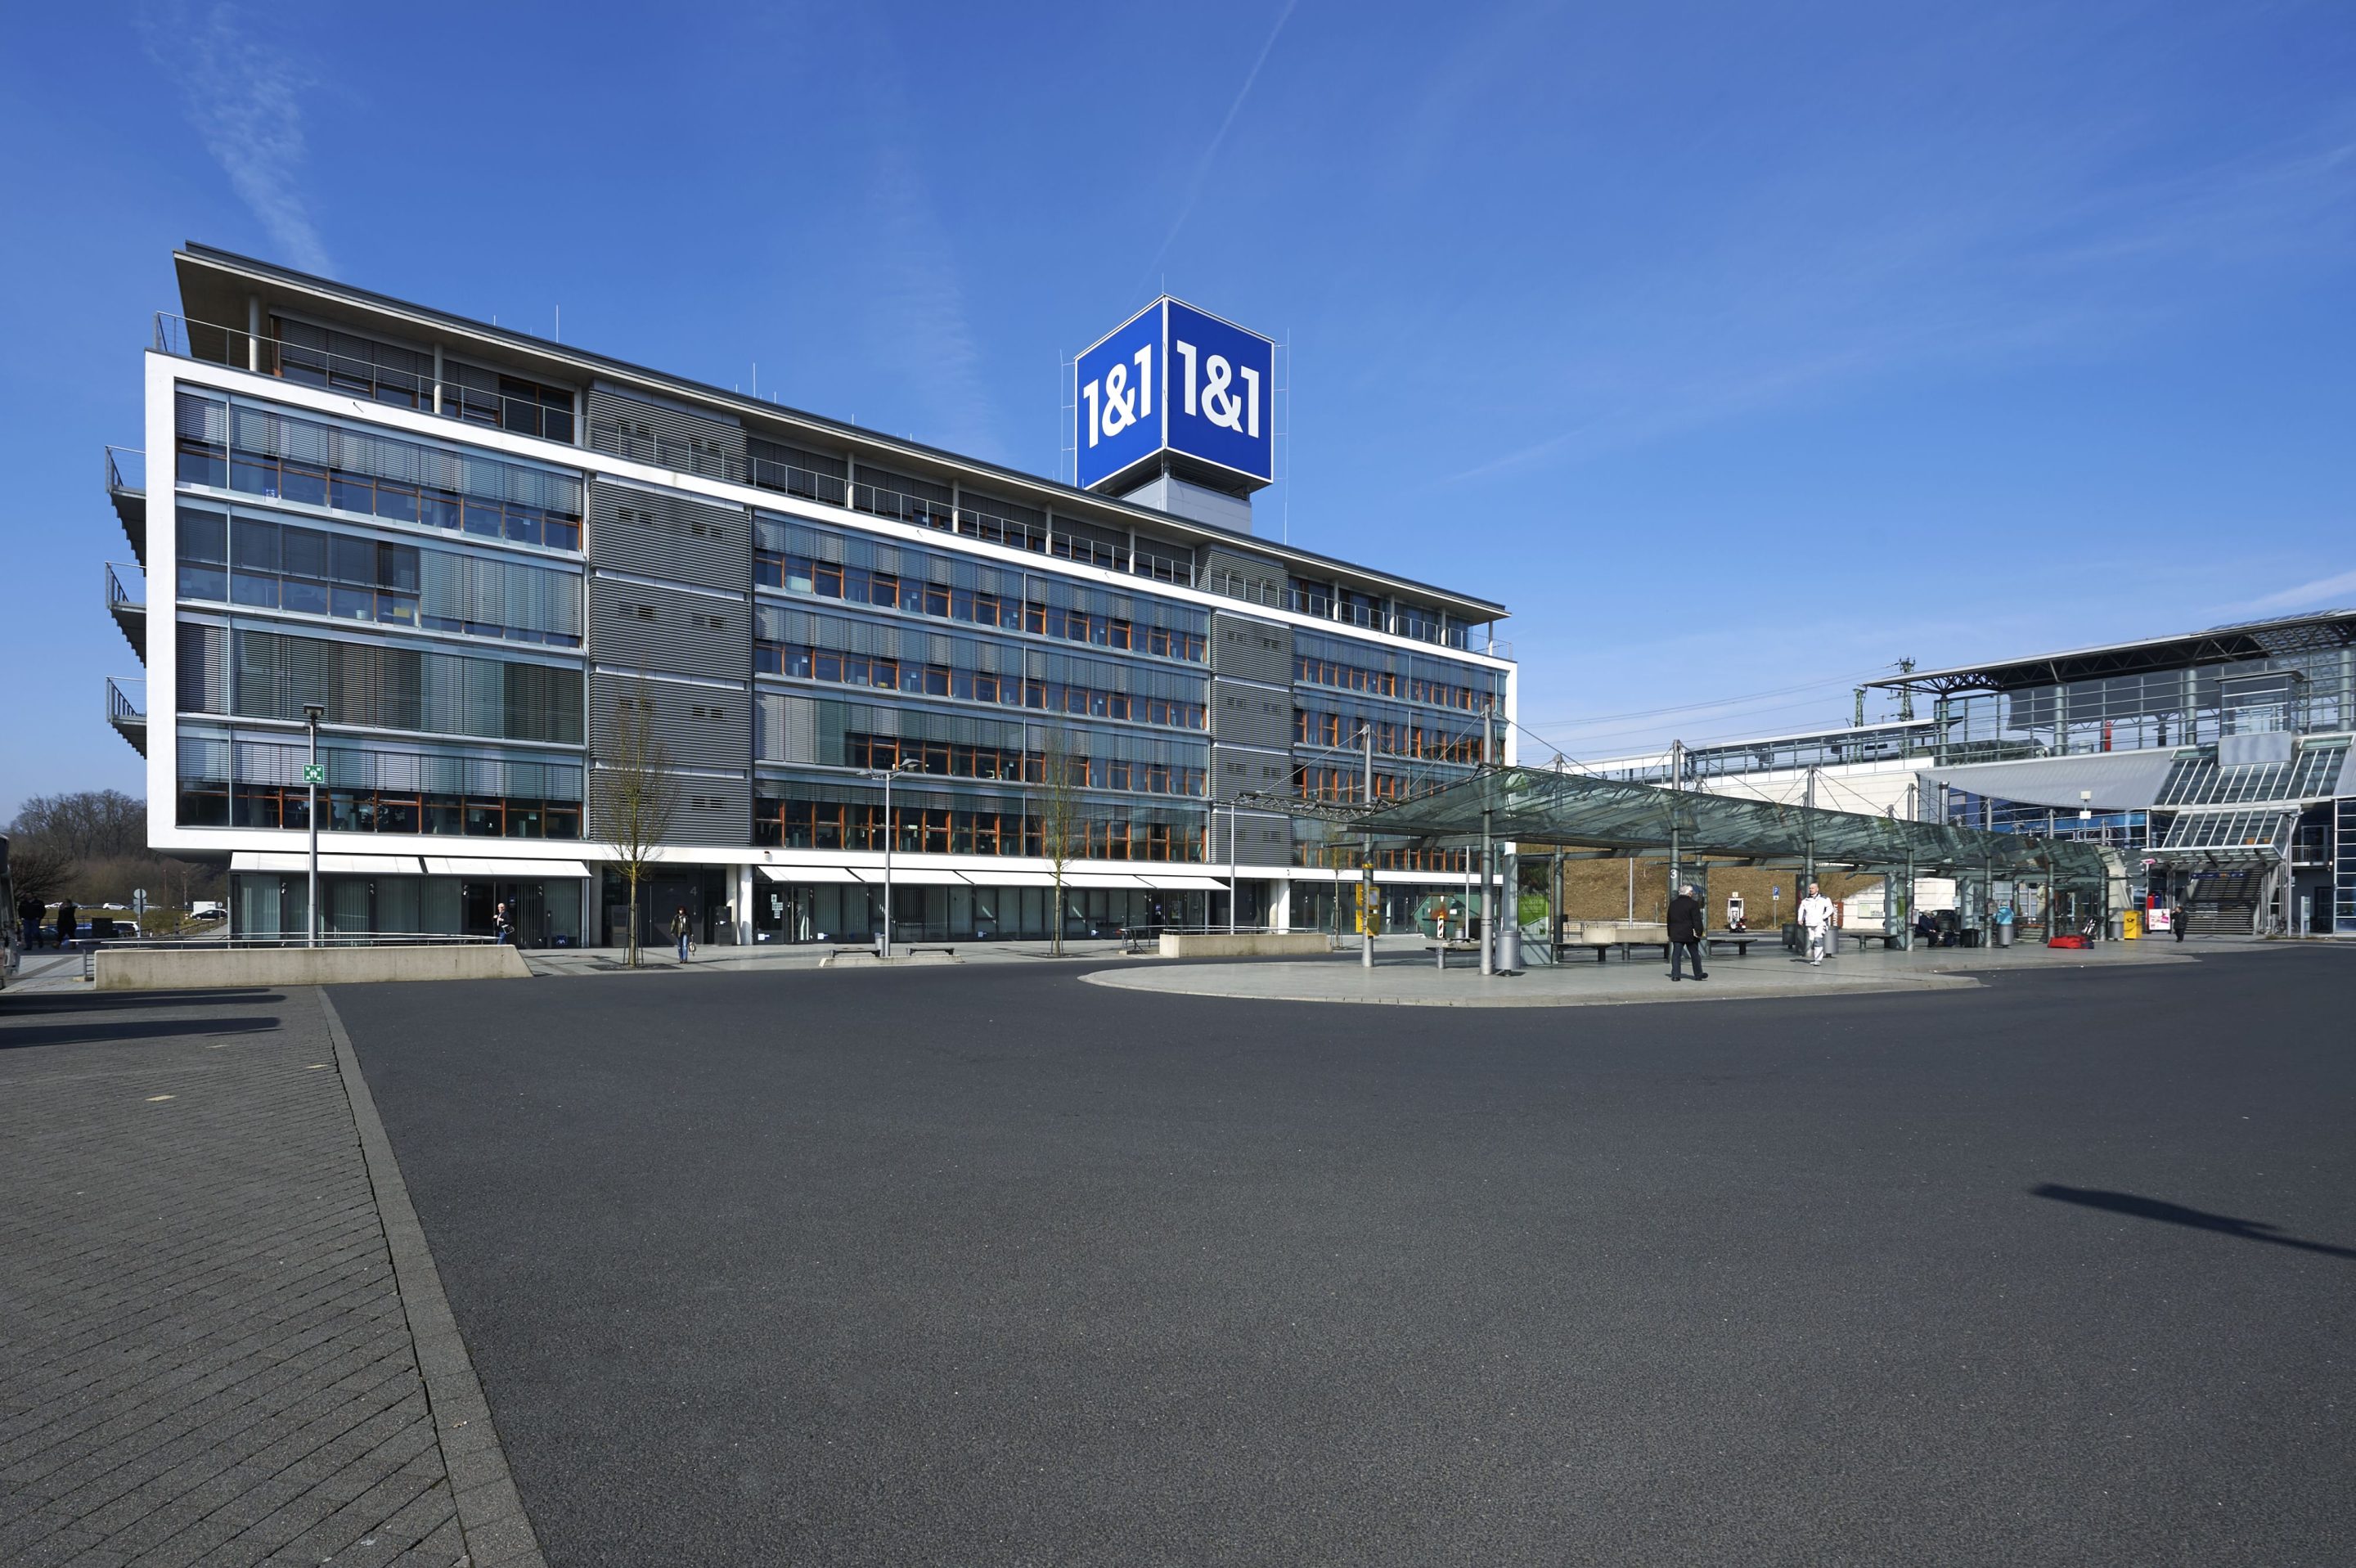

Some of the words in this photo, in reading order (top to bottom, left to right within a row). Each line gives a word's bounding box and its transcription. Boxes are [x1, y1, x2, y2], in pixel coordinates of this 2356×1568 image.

[1083, 344, 1151, 448] 1&1
[1176, 339, 1259, 438] 1&1
[1670, 869, 1677, 878] 3
[1906, 879, 1913, 887] 2
